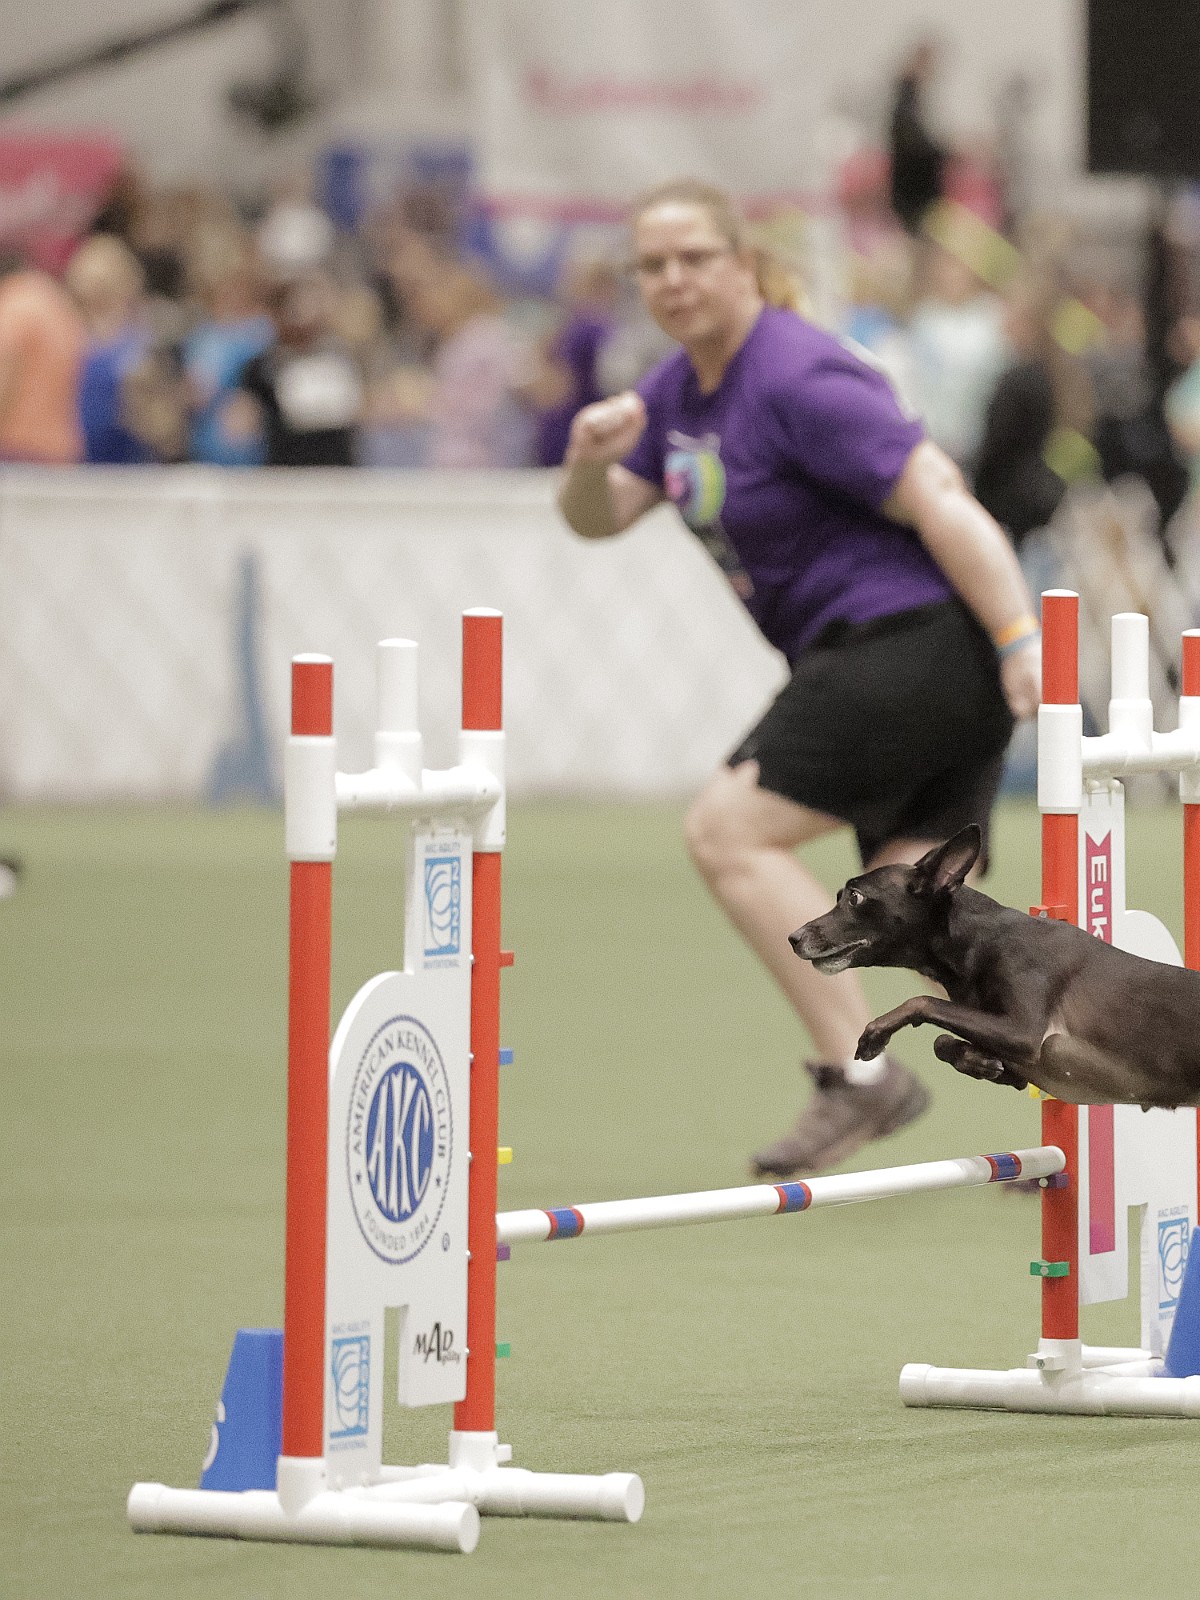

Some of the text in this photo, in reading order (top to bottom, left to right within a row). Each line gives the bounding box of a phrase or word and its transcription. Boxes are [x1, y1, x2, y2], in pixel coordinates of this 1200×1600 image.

[353, 1030, 447, 1159] AMERICAN KENNEL CLUB
[367, 1068, 432, 1218] AKC
[364, 1209, 406, 1251] FOUNDED
[413, 1322, 453, 1363] MAD
